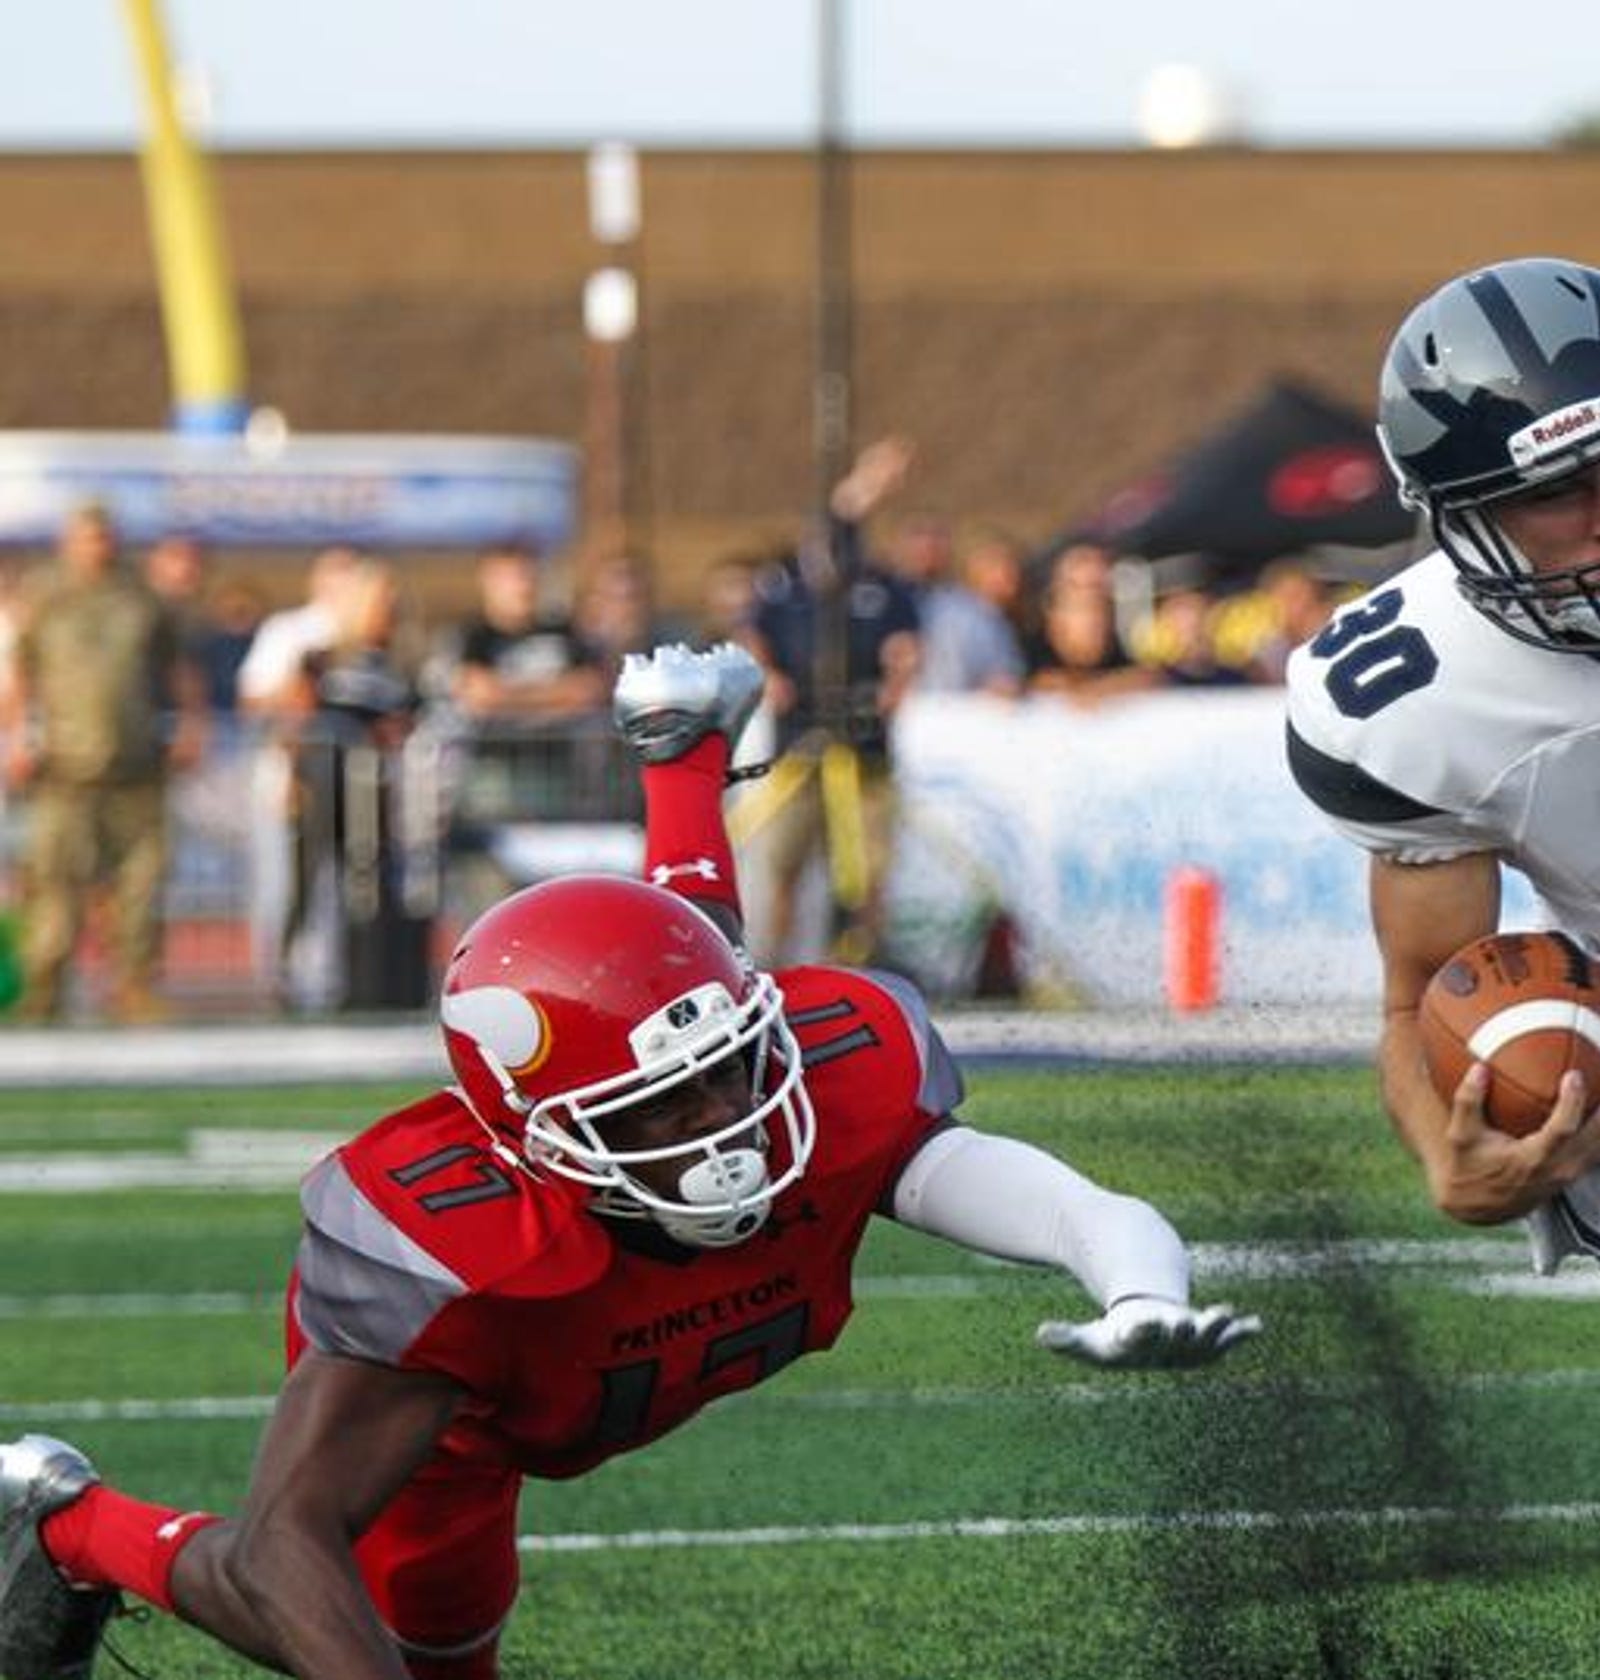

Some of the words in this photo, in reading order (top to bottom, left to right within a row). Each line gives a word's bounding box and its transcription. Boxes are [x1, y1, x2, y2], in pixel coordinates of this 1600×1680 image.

[1310, 588, 1439, 719] 30
[388, 1144, 519, 1215] 17
[610, 1271, 799, 1355] PRINCETON
